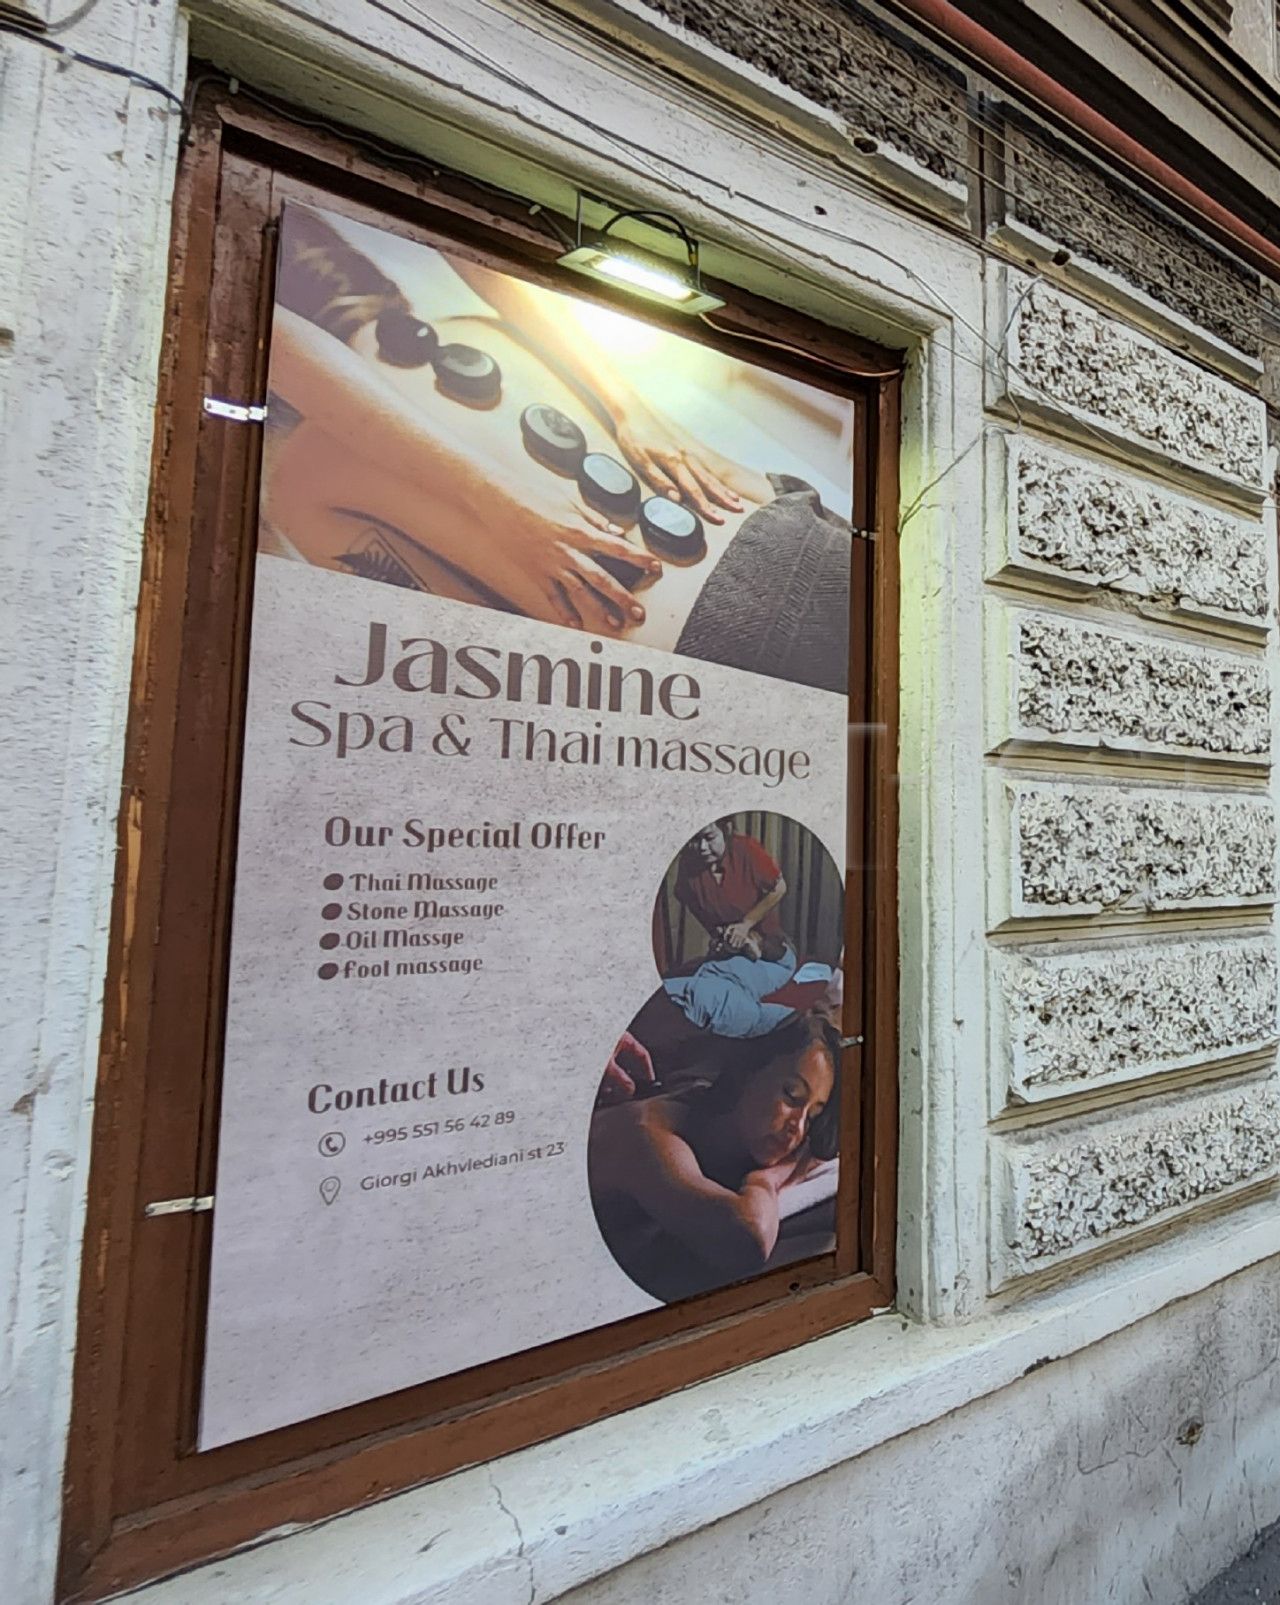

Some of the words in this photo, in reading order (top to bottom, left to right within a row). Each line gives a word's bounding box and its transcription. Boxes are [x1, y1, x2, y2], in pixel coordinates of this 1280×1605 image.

[335, 622, 701, 721] Jasmine
[289, 700, 415, 759] Spa
[432, 712, 472, 757] &
[490, 716, 602, 767] Thai
[617, 734, 811, 788] massage
[324, 816, 394, 847] Our
[402, 818, 522, 853] Special
[531, 821, 606, 850] Offer
[348, 872, 401, 892] Thai
[407, 872, 498, 894] Massage
[346, 901, 409, 921] Stone
[413, 900, 505, 920] Massage
[345, 930, 377, 950] Oil
[382, 929, 464, 949] Massge
[396, 957, 484, 976] massage
[307, 1072, 437, 1114] Contact
[447, 1066, 486, 1096] Us
[363, 1126, 408, 1145] +995
[412, 1121, 440, 1139] 551
[444, 1118, 465, 1134] 56
[470, 1114, 491, 1128] 42
[494, 1110, 516, 1125] 89
[360, 1168, 417, 1191] Giorgi
[422, 1149, 524, 1180] Akhvlediani
[527, 1147, 542, 1160] st
[546, 1142, 565, 1157] 23
